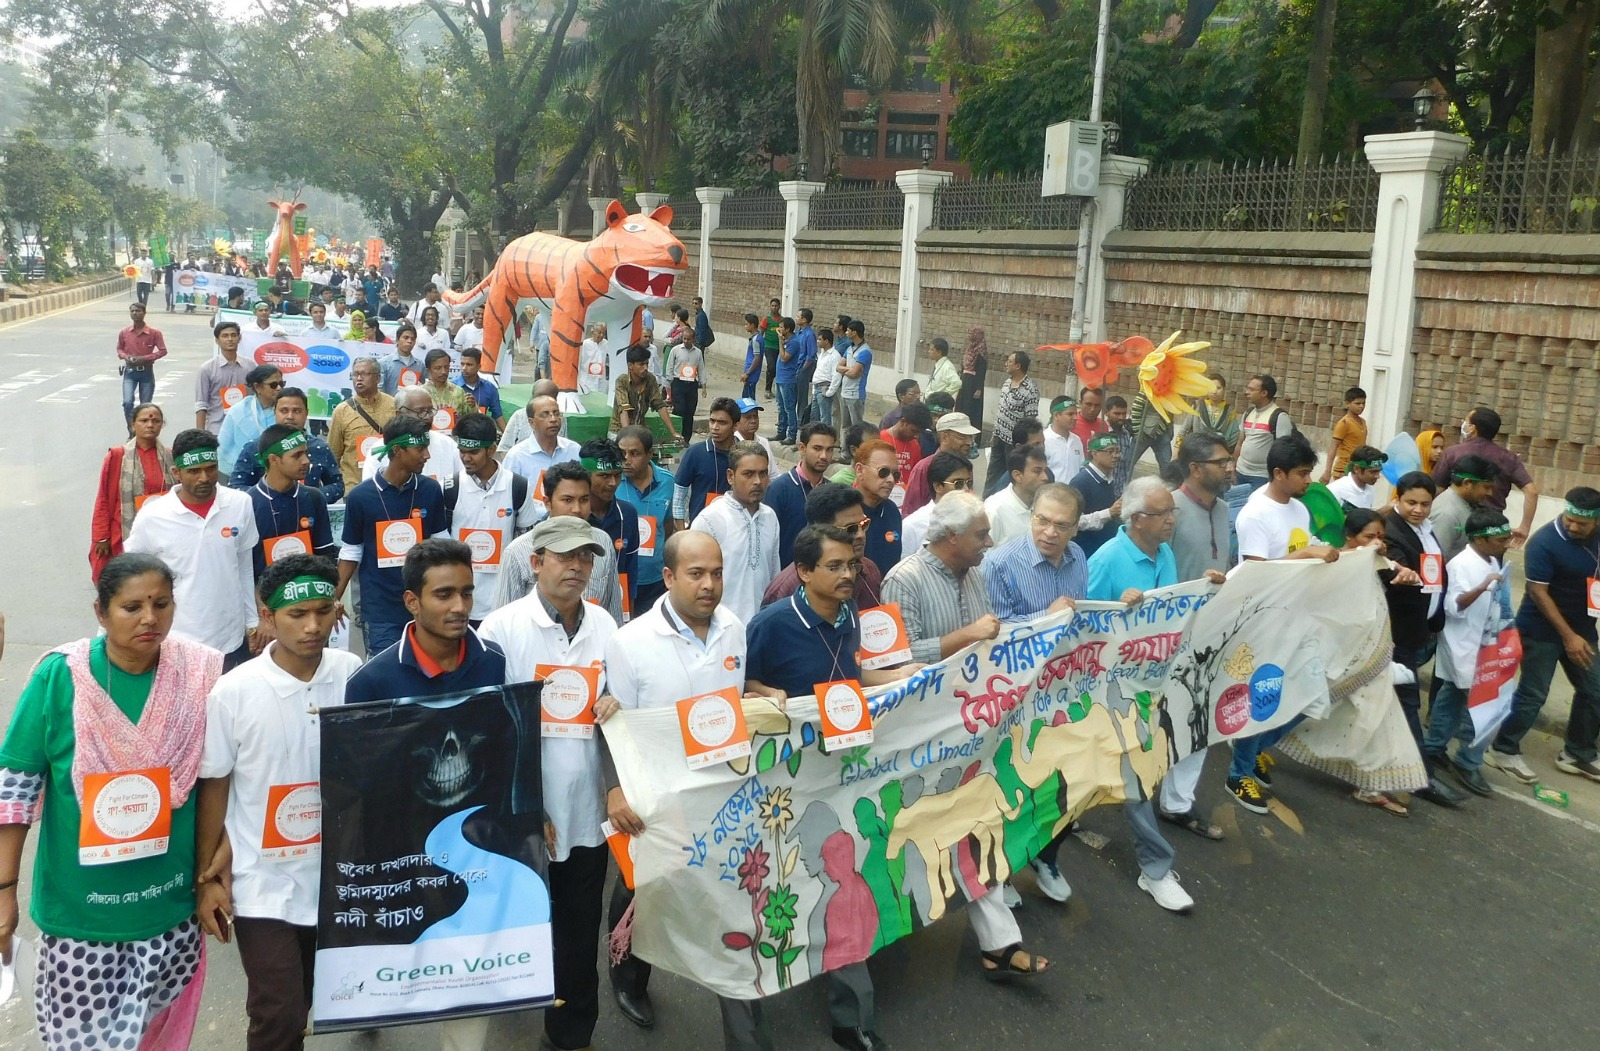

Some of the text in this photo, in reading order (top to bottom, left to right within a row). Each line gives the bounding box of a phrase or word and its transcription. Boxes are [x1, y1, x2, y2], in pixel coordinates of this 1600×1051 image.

[183, 452, 200, 466] গ্রীন
[284, 581, 310, 600] গ্রীন
[961, 653, 979, 683] ও
[841, 751, 901, 787] Global
[1056, 687, 1069, 704] a
[336, 861, 376, 878] অবৈধ
[380, 853, 435, 874] দখলদার
[335, 868, 488, 901] ভূমিদস্যুদের কবল থেকে
[333, 905, 424, 928] নদী বাঁচাও
[375, 962, 454, 983] Green
[463, 950, 532, 973] Voice
